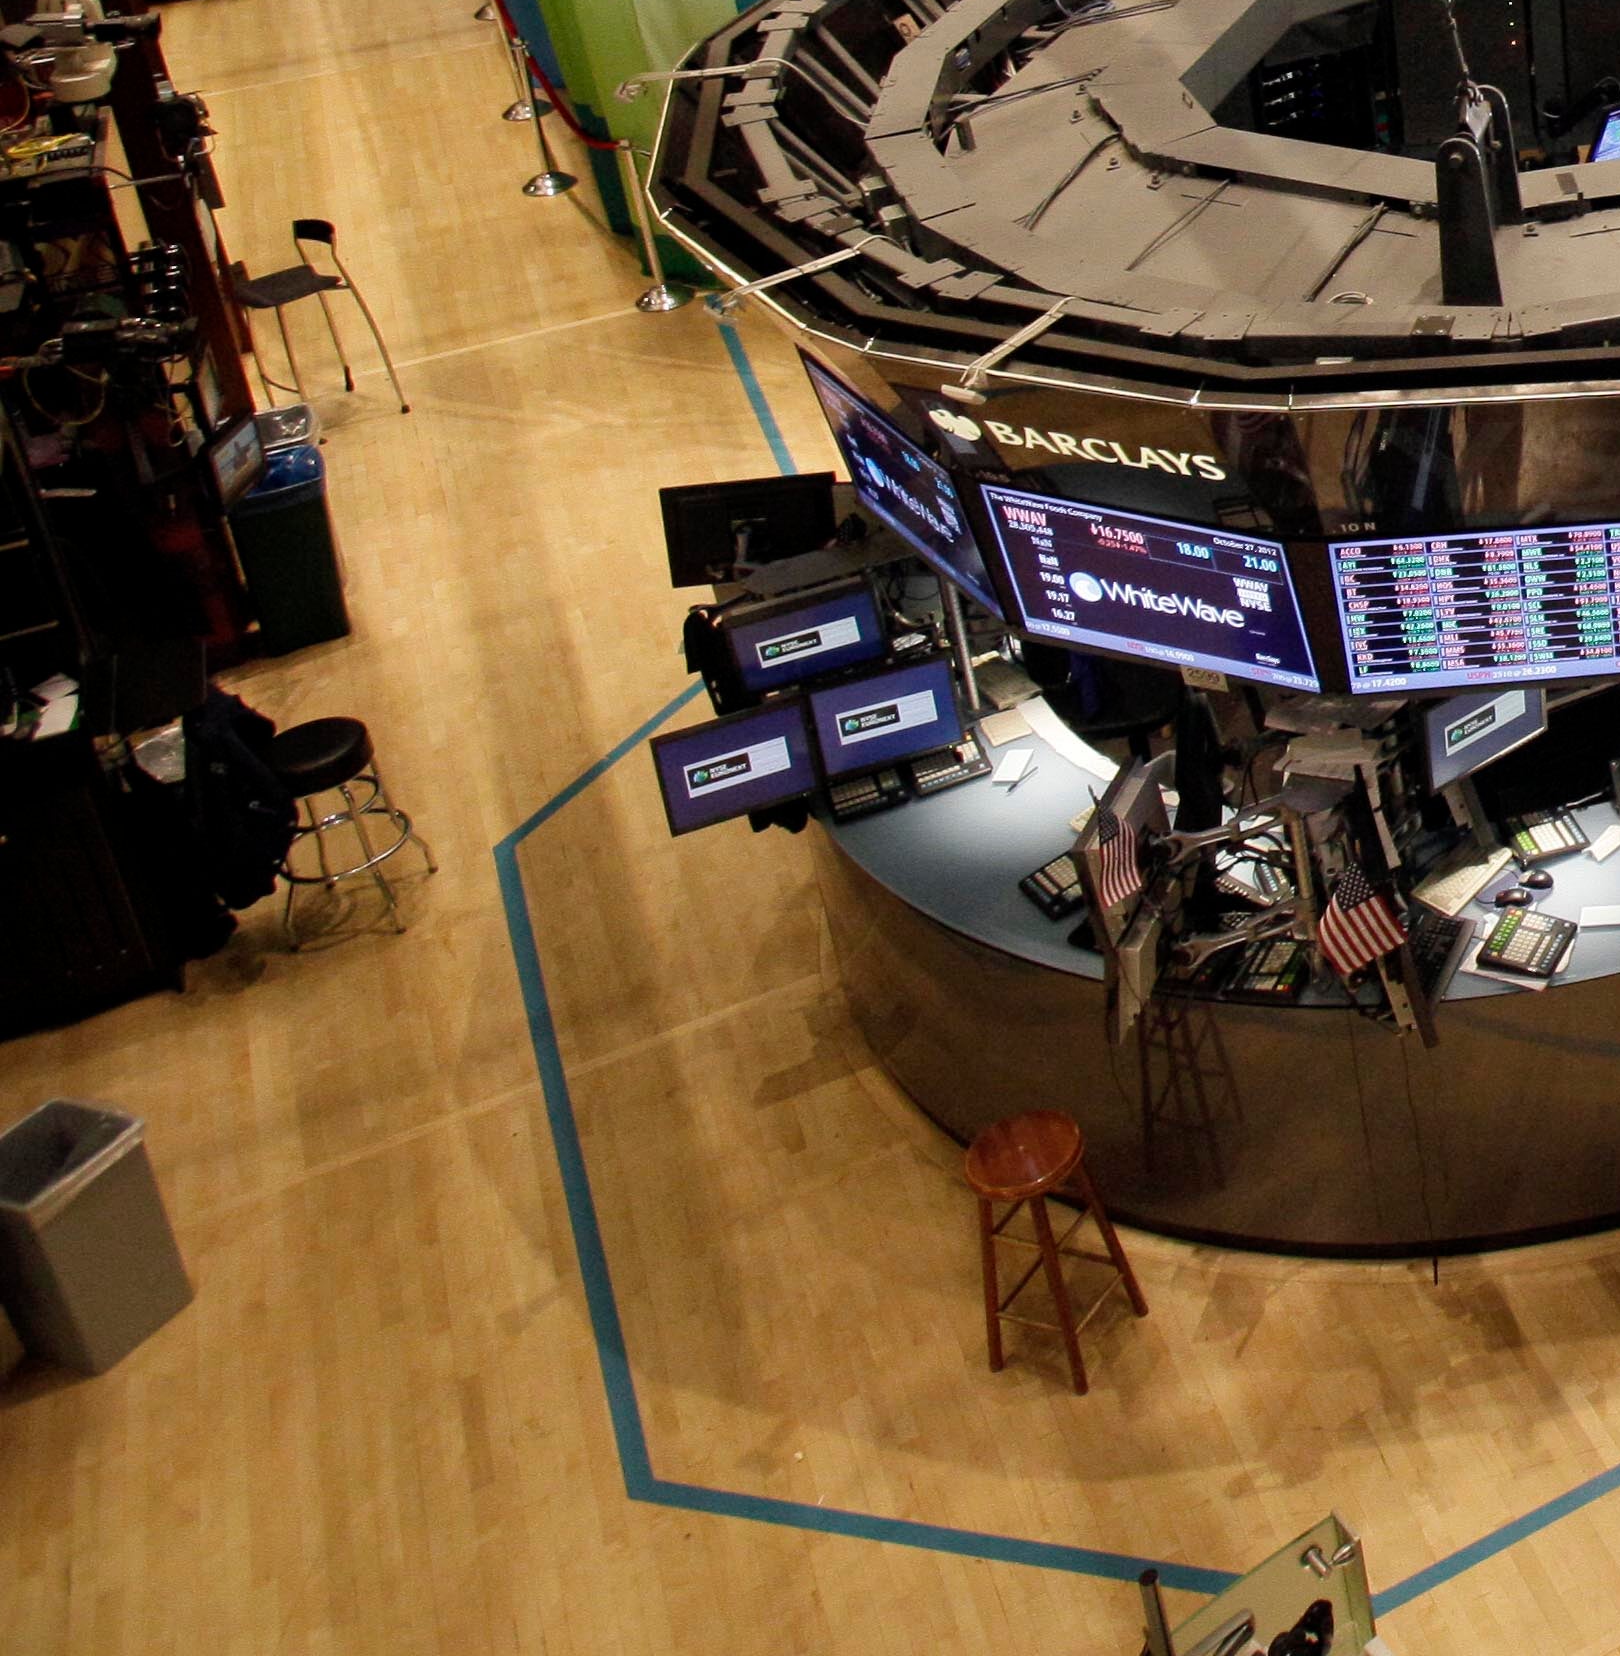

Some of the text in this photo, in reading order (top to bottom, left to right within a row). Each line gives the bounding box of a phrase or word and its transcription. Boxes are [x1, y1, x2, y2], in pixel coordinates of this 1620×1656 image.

[983, 418, 1226, 481] BARCLAYS
[1002, 505, 1047, 527] WWAV
[1099, 524, 1144, 545] 16.7500
[1176, 542, 1211, 560] 18.00
[1243, 555, 1278, 573] 21.00
[1100, 578, 1246, 629] WhiteWave
[1240, 598, 1272, 612] NYSE
